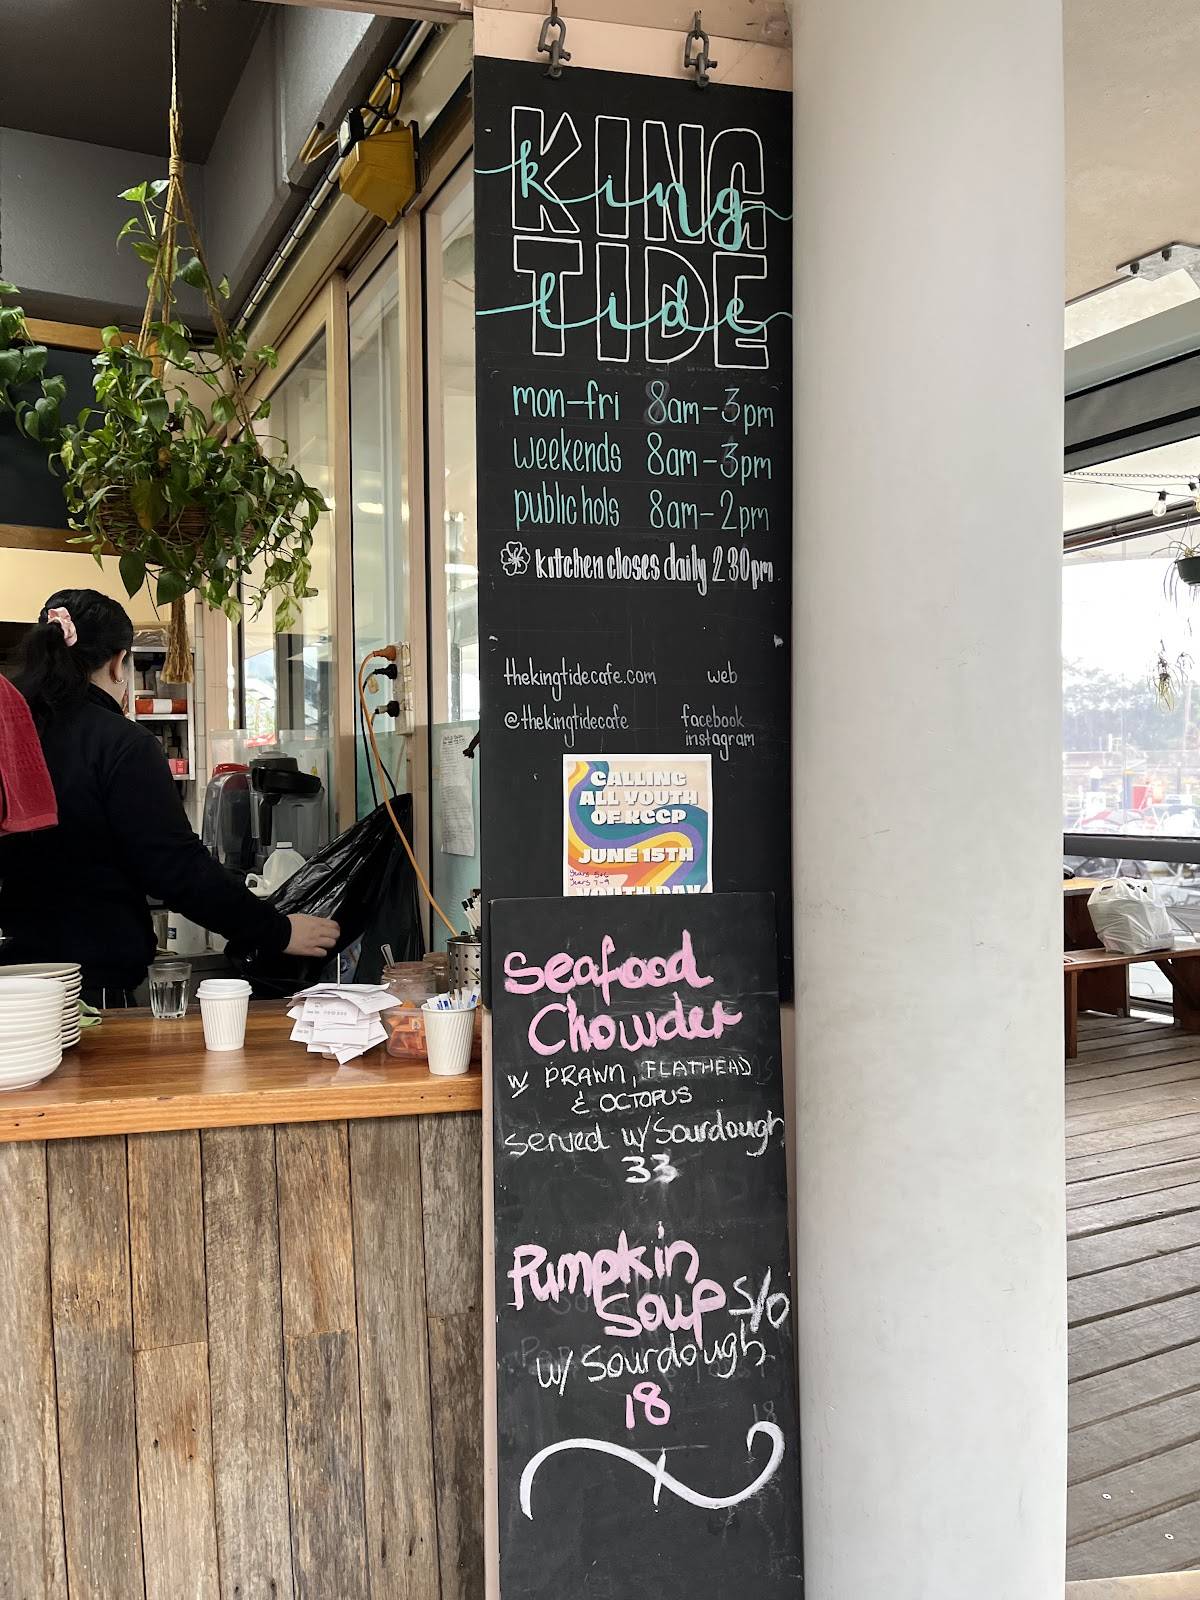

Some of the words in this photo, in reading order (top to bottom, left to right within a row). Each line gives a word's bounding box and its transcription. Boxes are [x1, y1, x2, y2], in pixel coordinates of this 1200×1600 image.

[474, 139, 792, 251] king
[511, 105, 767, 250] KING
[475, 272, 792, 335] tide
[513, 234, 769, 369] TIDE
[512, 379, 620, 422] mon-fri
[512, 427, 622, 474] weekends
[513, 481, 577, 532] public
[581, 484, 620, 528] hols
[534, 547, 605, 579] kitchen
[606, 546, 661, 581] closes
[663, 541, 708, 596] daily
[503, 656, 657, 702] thekingtidecafe.com
[707, 661, 738, 684] web
[504, 703, 630, 748] @thekingtidecafe
[680, 703, 745, 728] facebook
[684, 730, 755, 761] instagram
[579, 790, 621, 807] ALL
[623, 790, 700, 807] YOUTH
[590, 770, 688, 788] CALLING
[590, 809, 622, 825] OF
[578, 847, 639, 865] JUNE
[641, 847, 695, 864] 15TH
[528, 991, 743, 1056] Chowder
[641, 1056, 752, 1079] FLATHEAD
[600, 1085, 693, 1112] OCTOPUS
[621, 1154, 680, 1184] 33
[507, 1220, 700, 1311] Pumpkin
[595, 1278, 727, 1350] Soup
[536, 1350, 573, 1396] w/
[625, 1381, 671, 1429] 18
